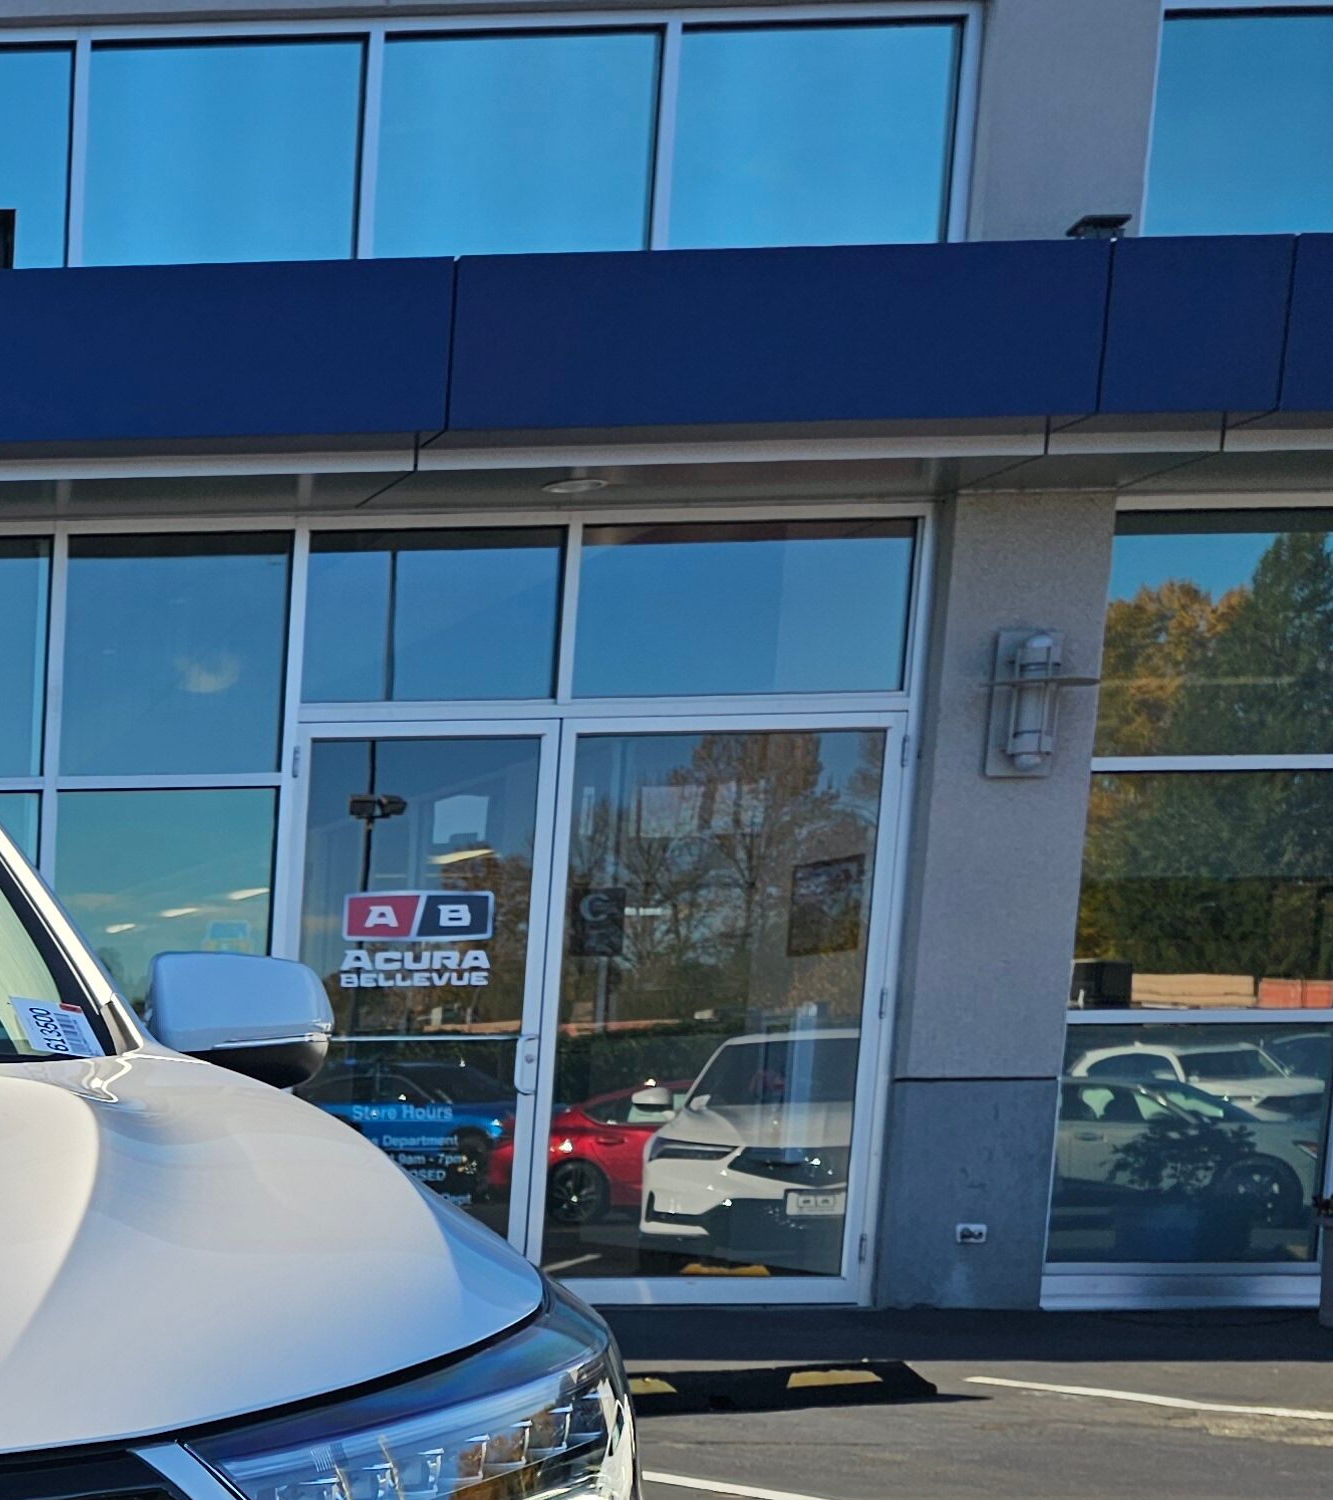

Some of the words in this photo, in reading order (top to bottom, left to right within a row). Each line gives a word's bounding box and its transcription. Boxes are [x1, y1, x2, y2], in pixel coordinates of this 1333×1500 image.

[363, 905, 399, 928] A
[437, 904, 471, 927] B
[340, 950, 490, 971] ACURA
[340, 972, 489, 988] BELLEVUE
[29, 1007, 69, 1051] 613500
[352, 1104, 397, 1120] Store
[402, 1103, 453, 1120] Hours
[382, 1134, 459, 1148] Department
